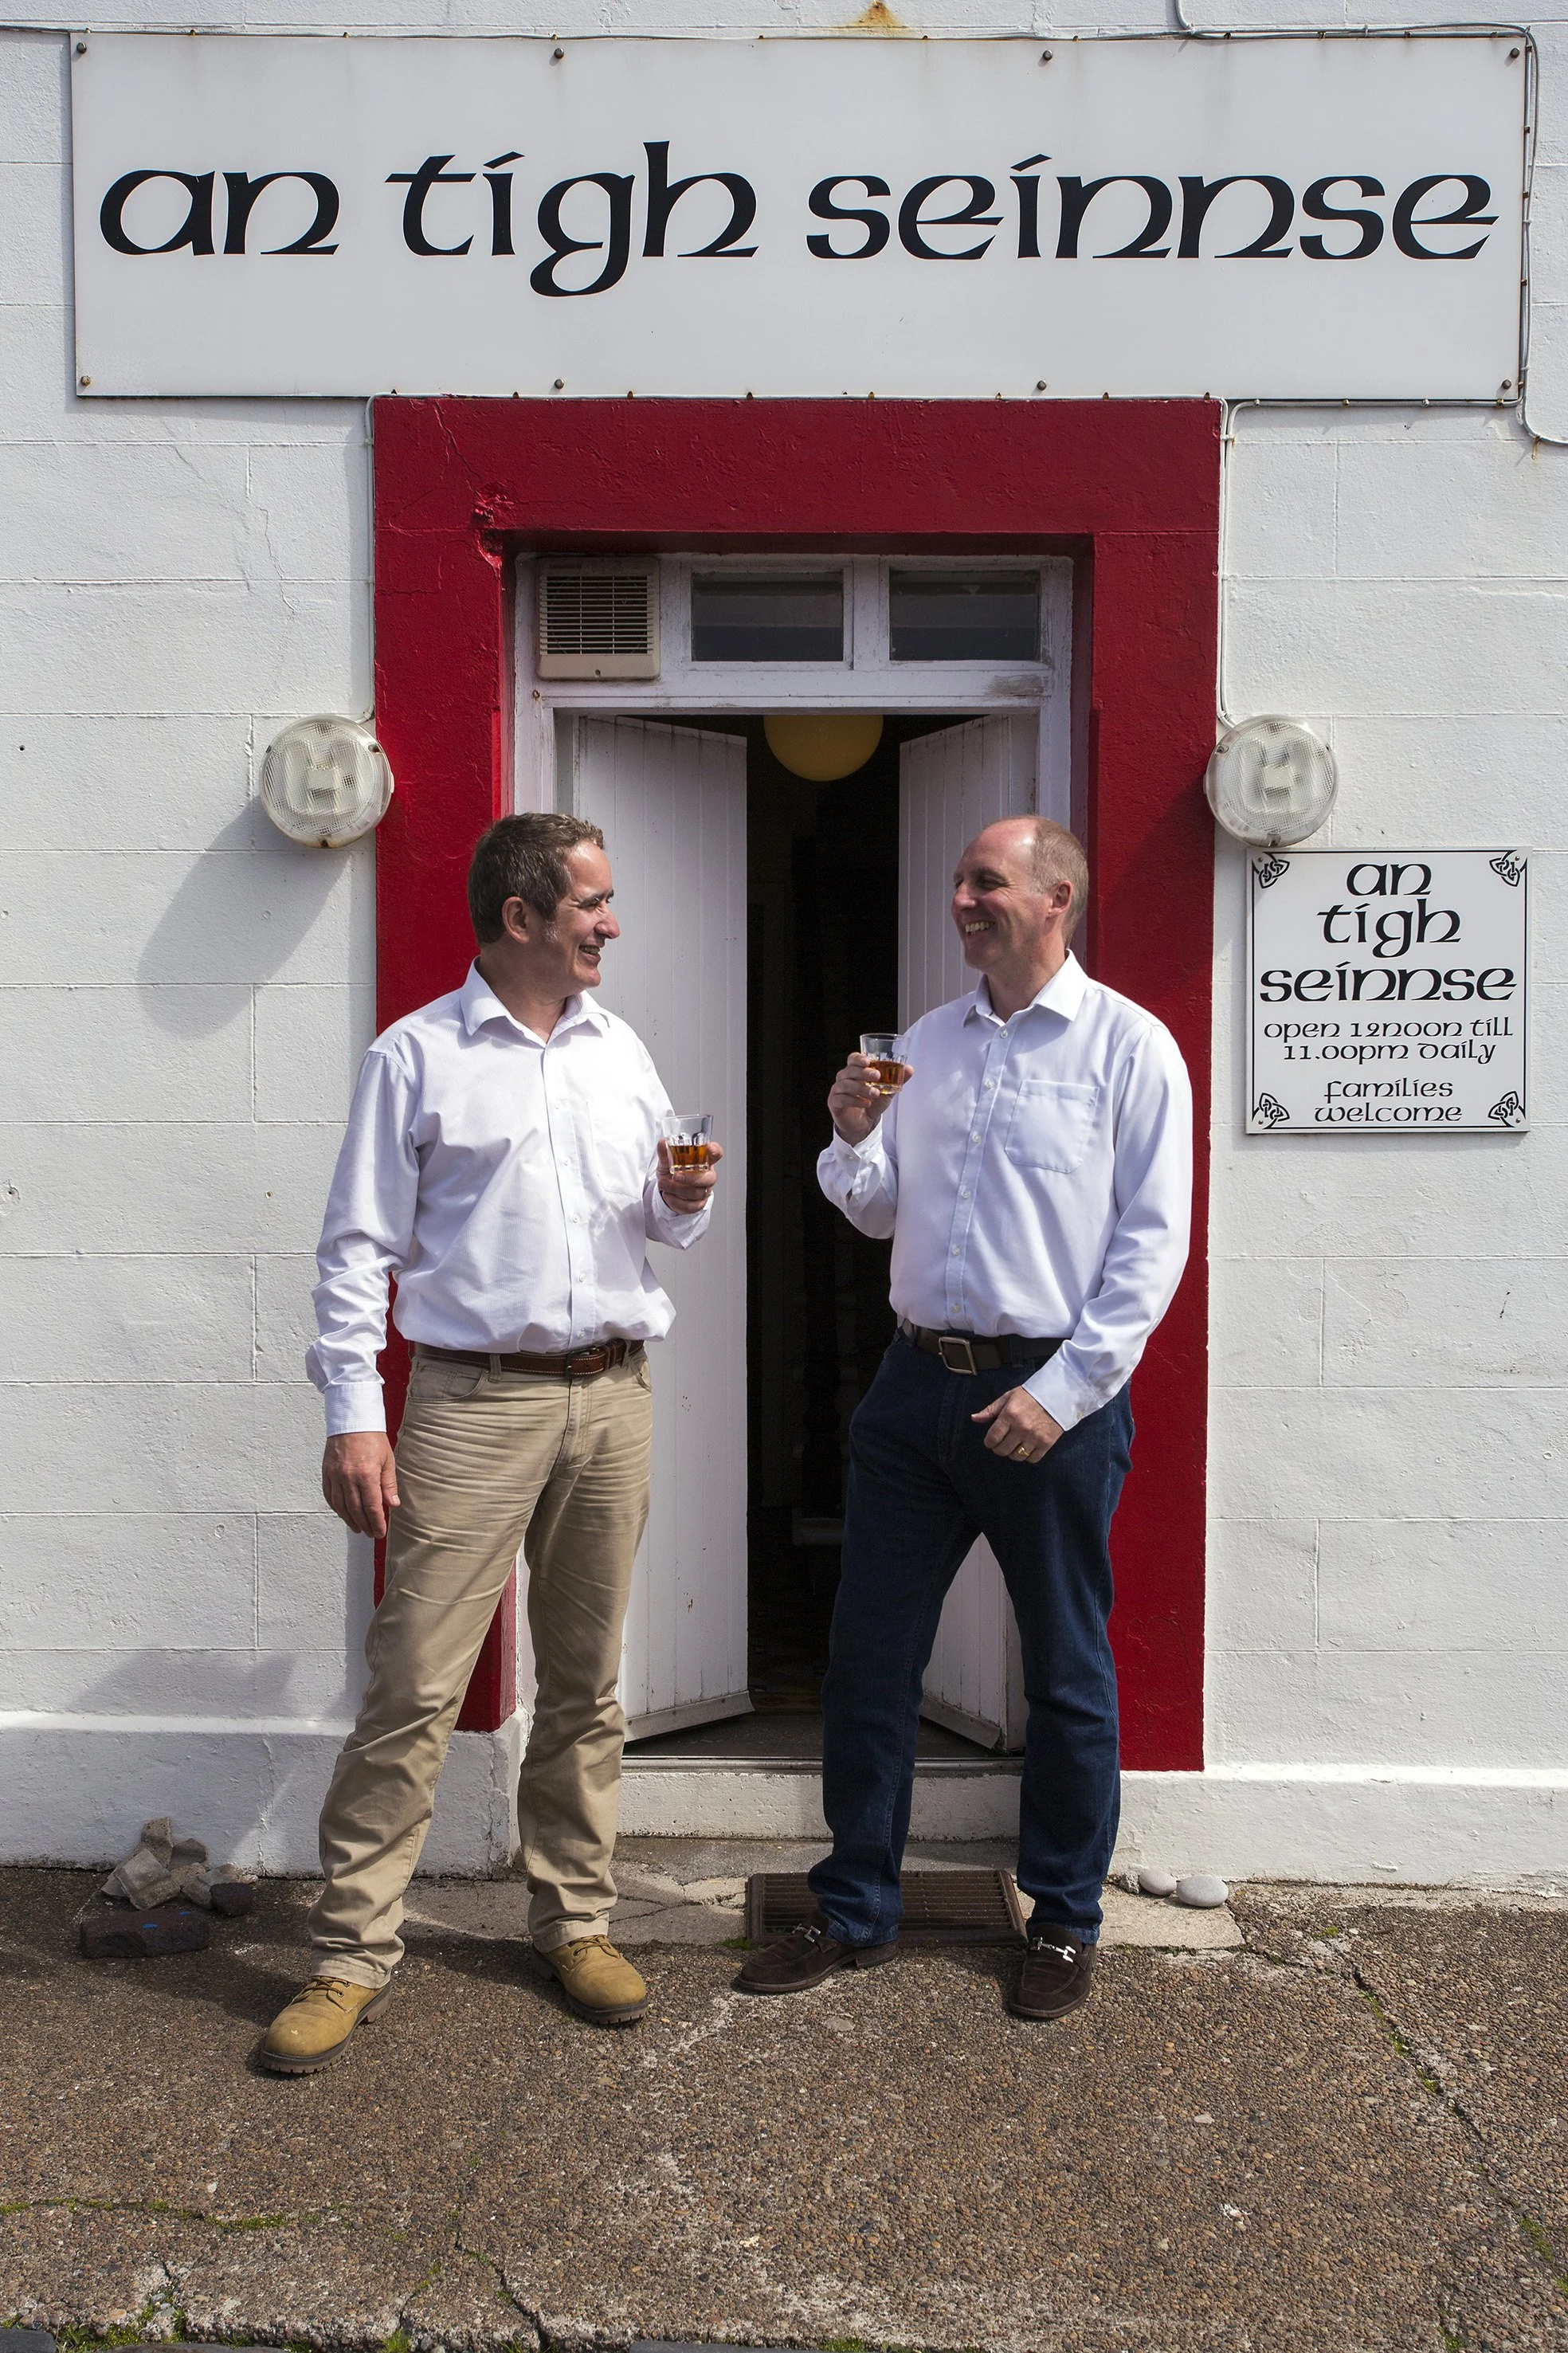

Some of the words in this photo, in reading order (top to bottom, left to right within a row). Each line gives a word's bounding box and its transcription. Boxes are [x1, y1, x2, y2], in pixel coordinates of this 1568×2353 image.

[100, 170, 339, 256] an
[1347, 864, 1432, 896] an
[1264, 1023, 1340, 1044] open
[1350, 1022, 1462, 1037] 12noon
[1470, 1017, 1513, 1037] till
[1417, 1039, 1496, 1065] daily
[1323, 1077, 1453, 1104] families
[1315, 1102, 1463, 1122] welcome
